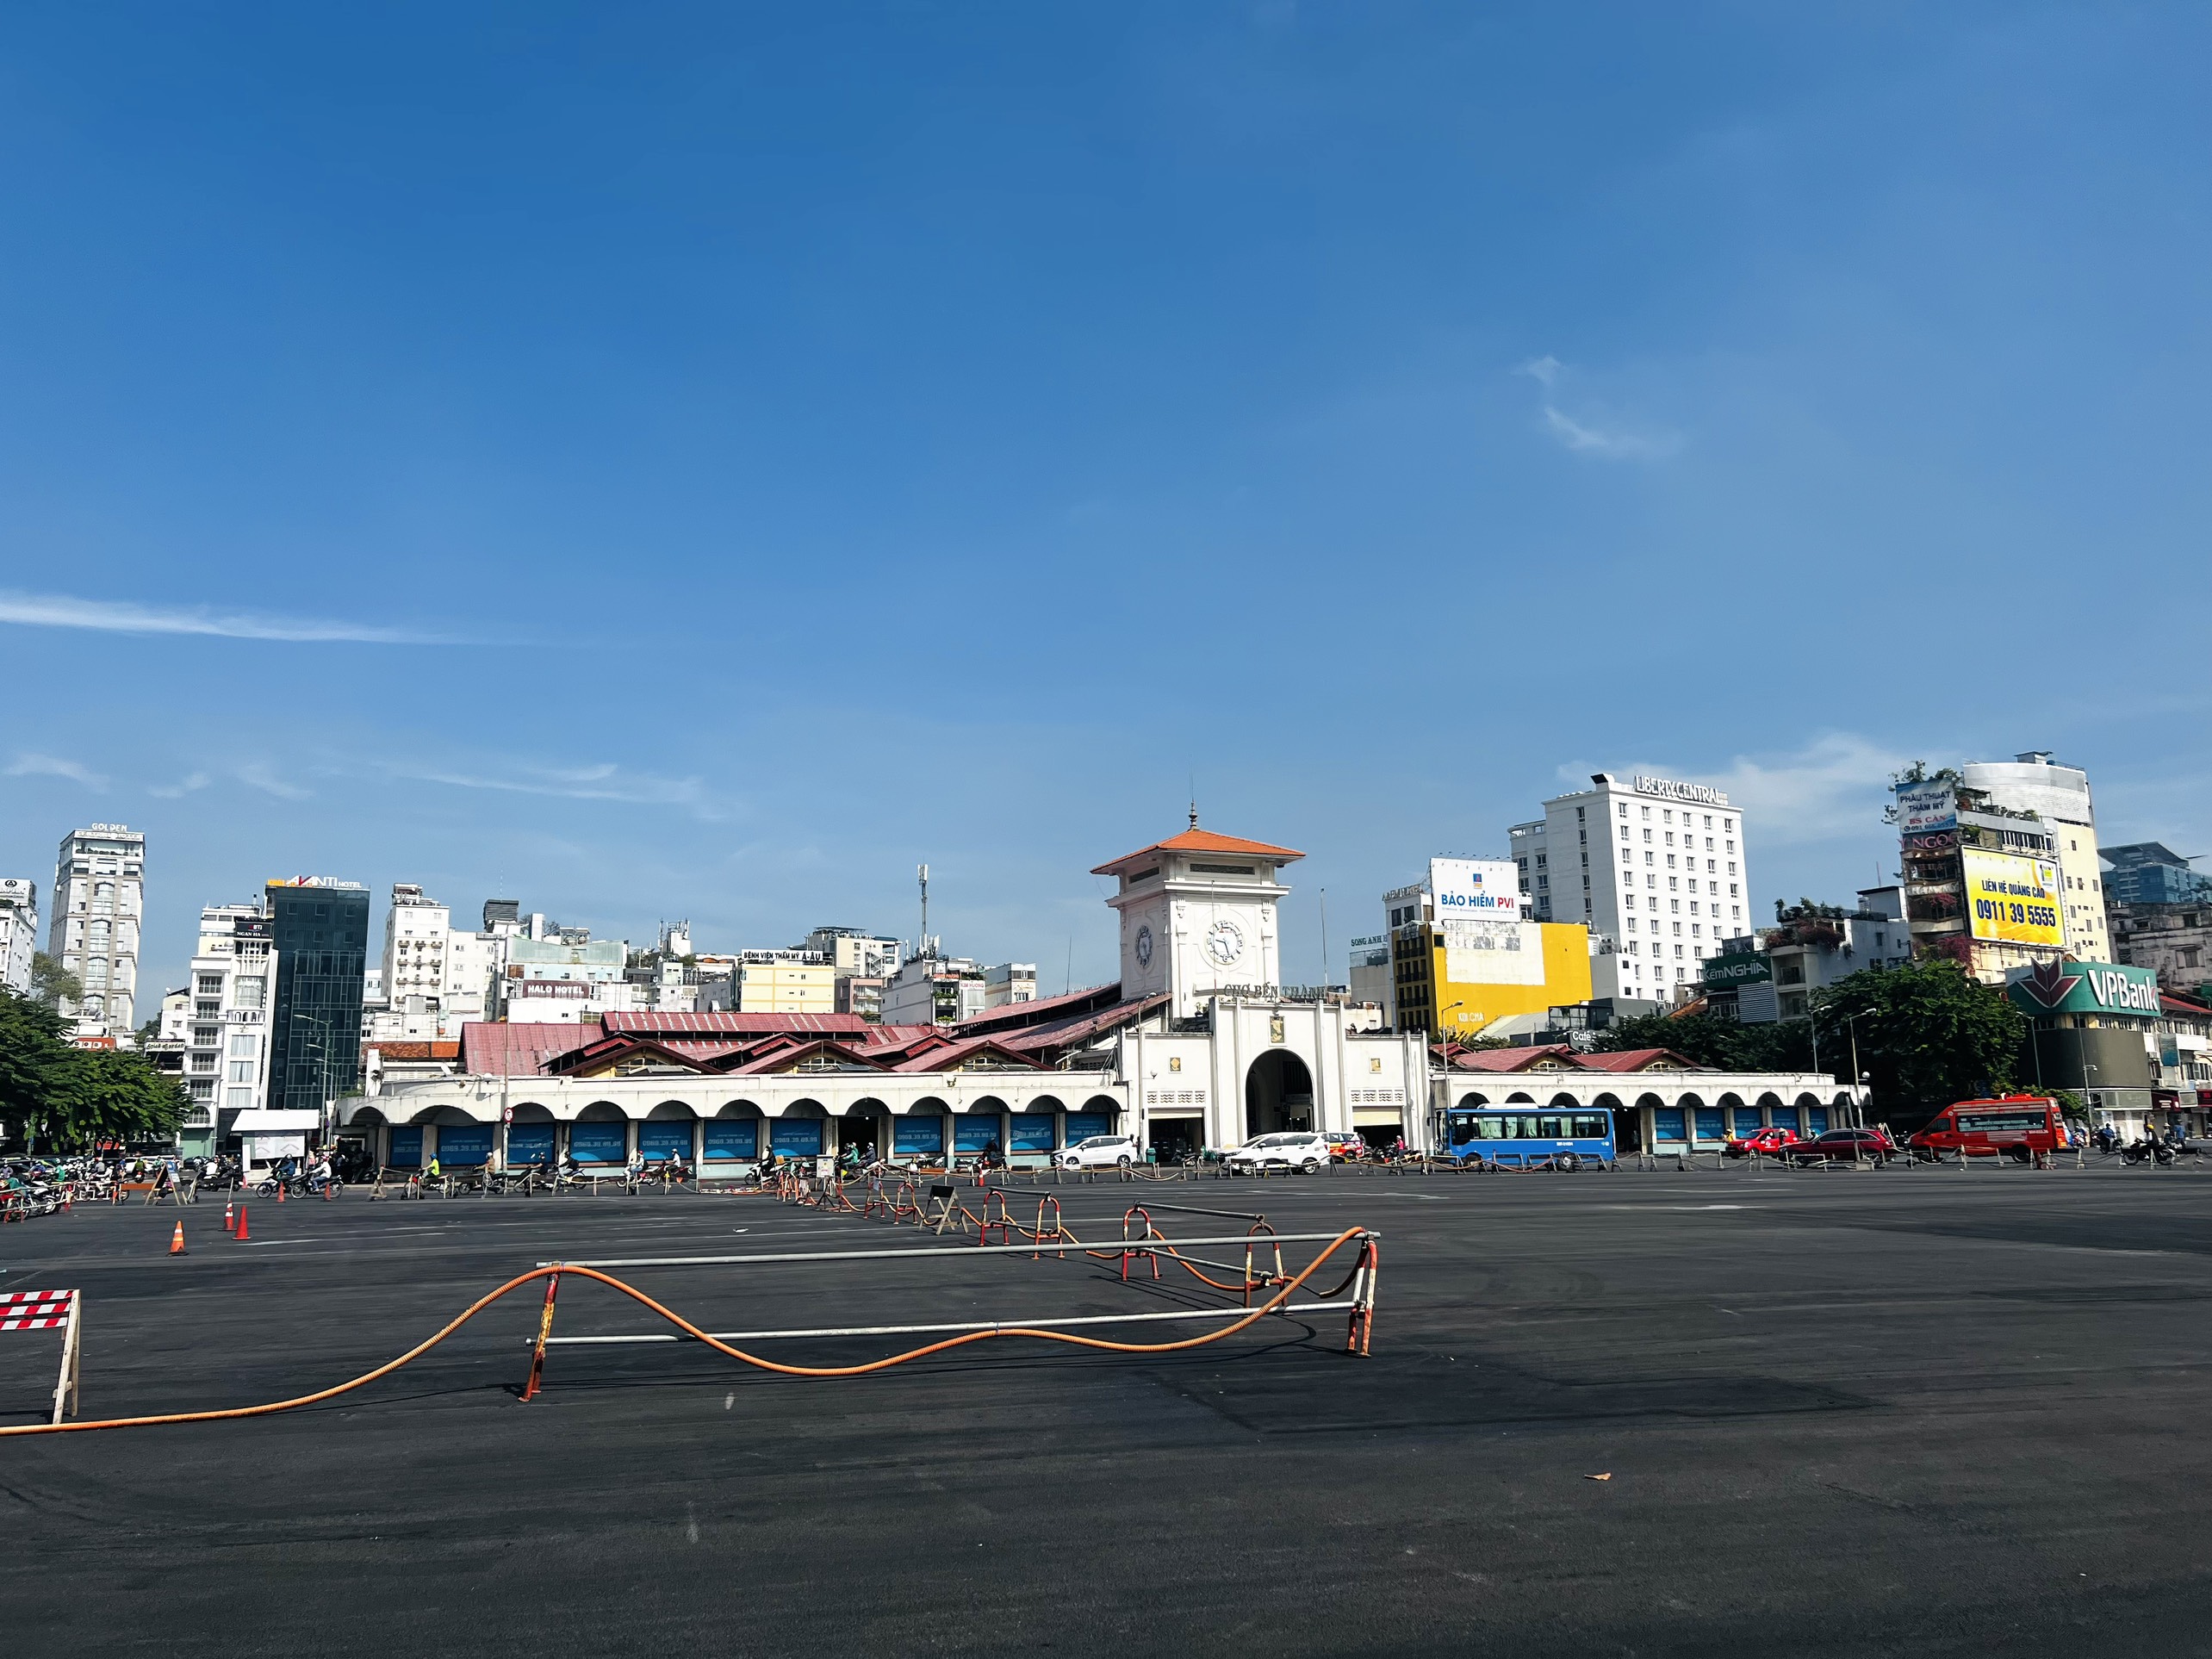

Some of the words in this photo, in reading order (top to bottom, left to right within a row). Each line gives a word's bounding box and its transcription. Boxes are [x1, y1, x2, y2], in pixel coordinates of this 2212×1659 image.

[1635, 775, 1675, 798] LIBERTY
[1676, 782, 1721, 804] CENTRAL
[91, 823, 127, 832] GOLDEN
[286, 875, 338, 887] AVANTI
[1981, 878, 1997, 892] LIÊN
[1998, 880, 2007, 896] HỆ
[2009, 881, 2031, 897] QUẢNG
[2032, 885, 2046, 898] CÁO
[1441, 891, 1465, 906] BẢO
[1469, 890, 1494, 908] HIỂM
[1497, 897, 1514, 909] PVI
[1976, 898, 2005, 921] 0911
[2009, 903, 2024, 923] 39
[2027, 904, 2056, 927] 5555
[1351, 937, 1367, 947] SONG
[1368, 935, 1382, 945] ANH
[527, 985, 552, 993] HALO
[1224, 984, 1251, 997] CHỢ
[1253, 981, 1279, 997] BẾN
[1283, 984, 1327, 999] THÀNH
[2087, 969, 2159, 1011] VPBank
[1572, 1030, 1591, 1041] Café
